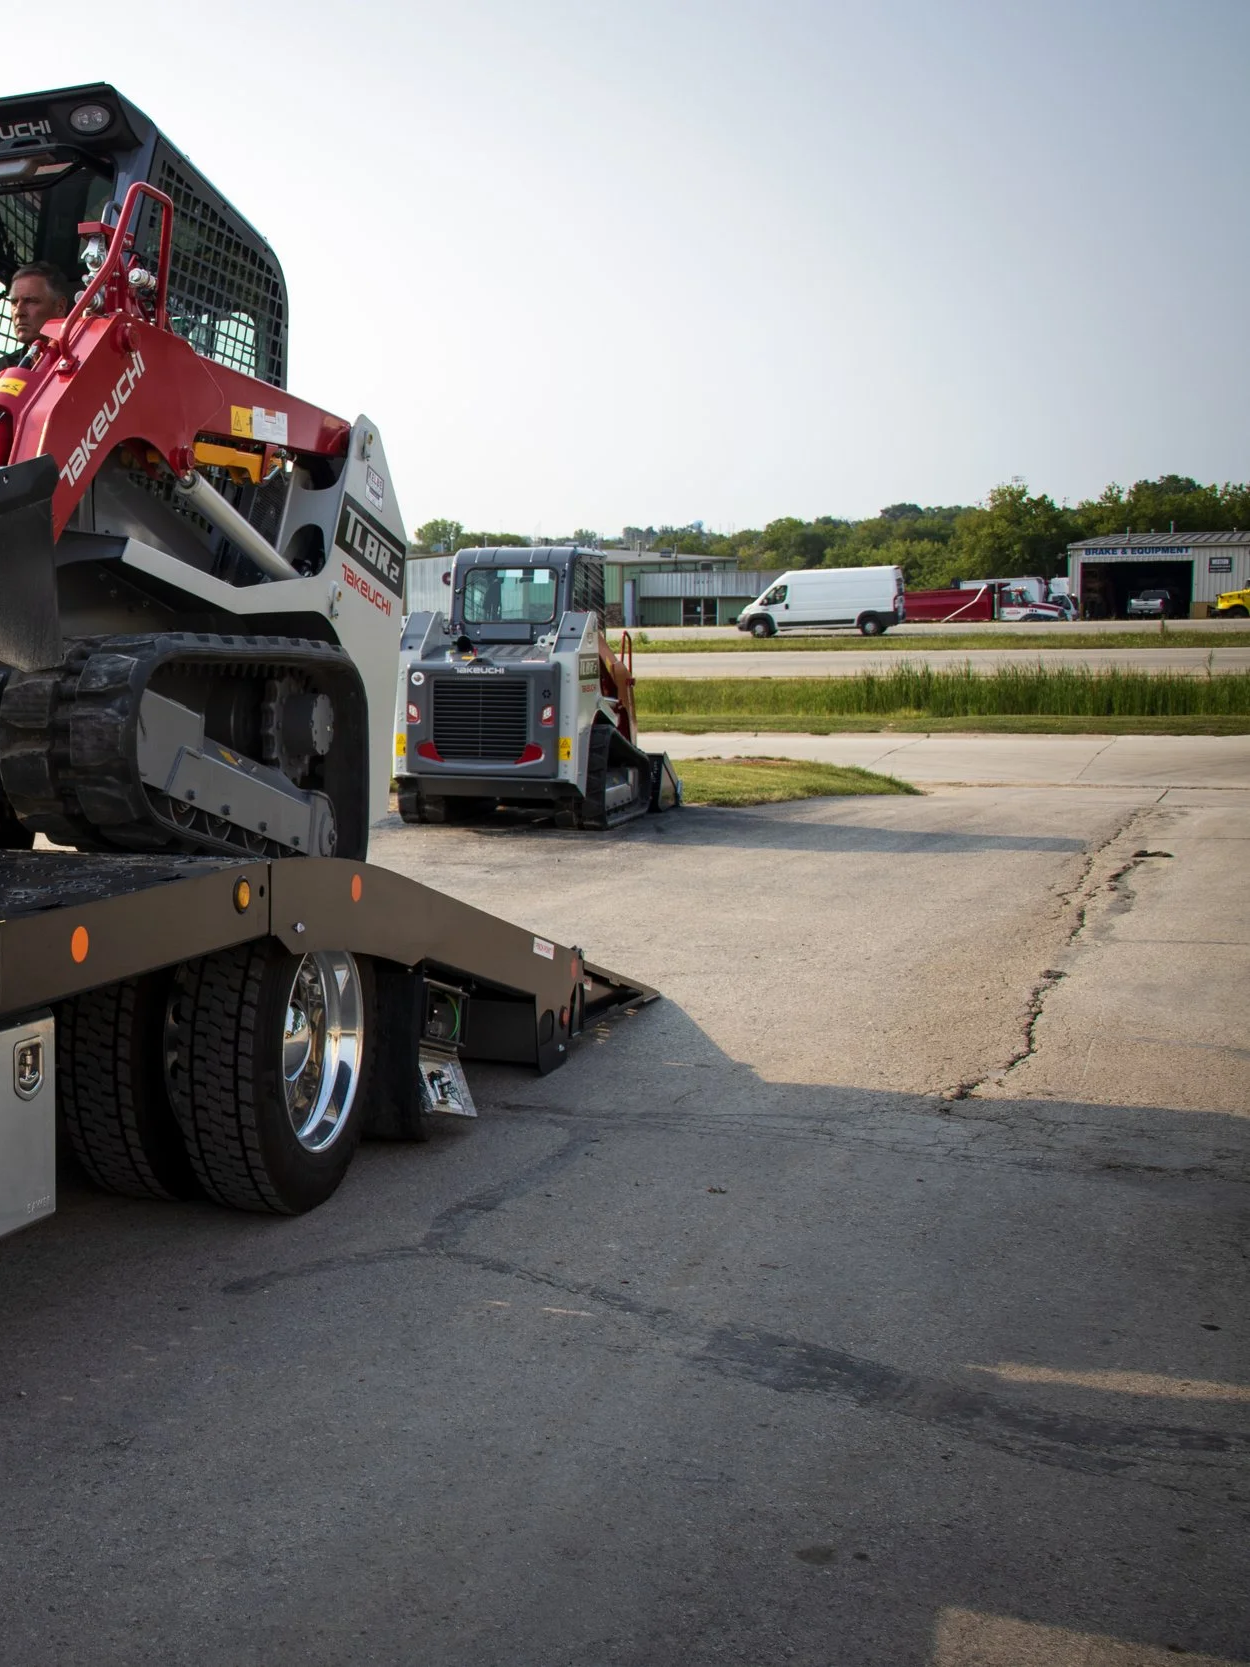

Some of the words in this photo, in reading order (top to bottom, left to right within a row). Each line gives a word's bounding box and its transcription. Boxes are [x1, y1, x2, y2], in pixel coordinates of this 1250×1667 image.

[59, 350, 146, 487] TAKEUCHI
[1084, 548, 1116, 556] BRAKE
[1120, 547, 1129, 555] &
[1130, 546, 1191, 555] EQUIPMENT
[342, 563, 392, 616] TAKEUCHI
[454, 666, 505, 675] TAKEUCHI
